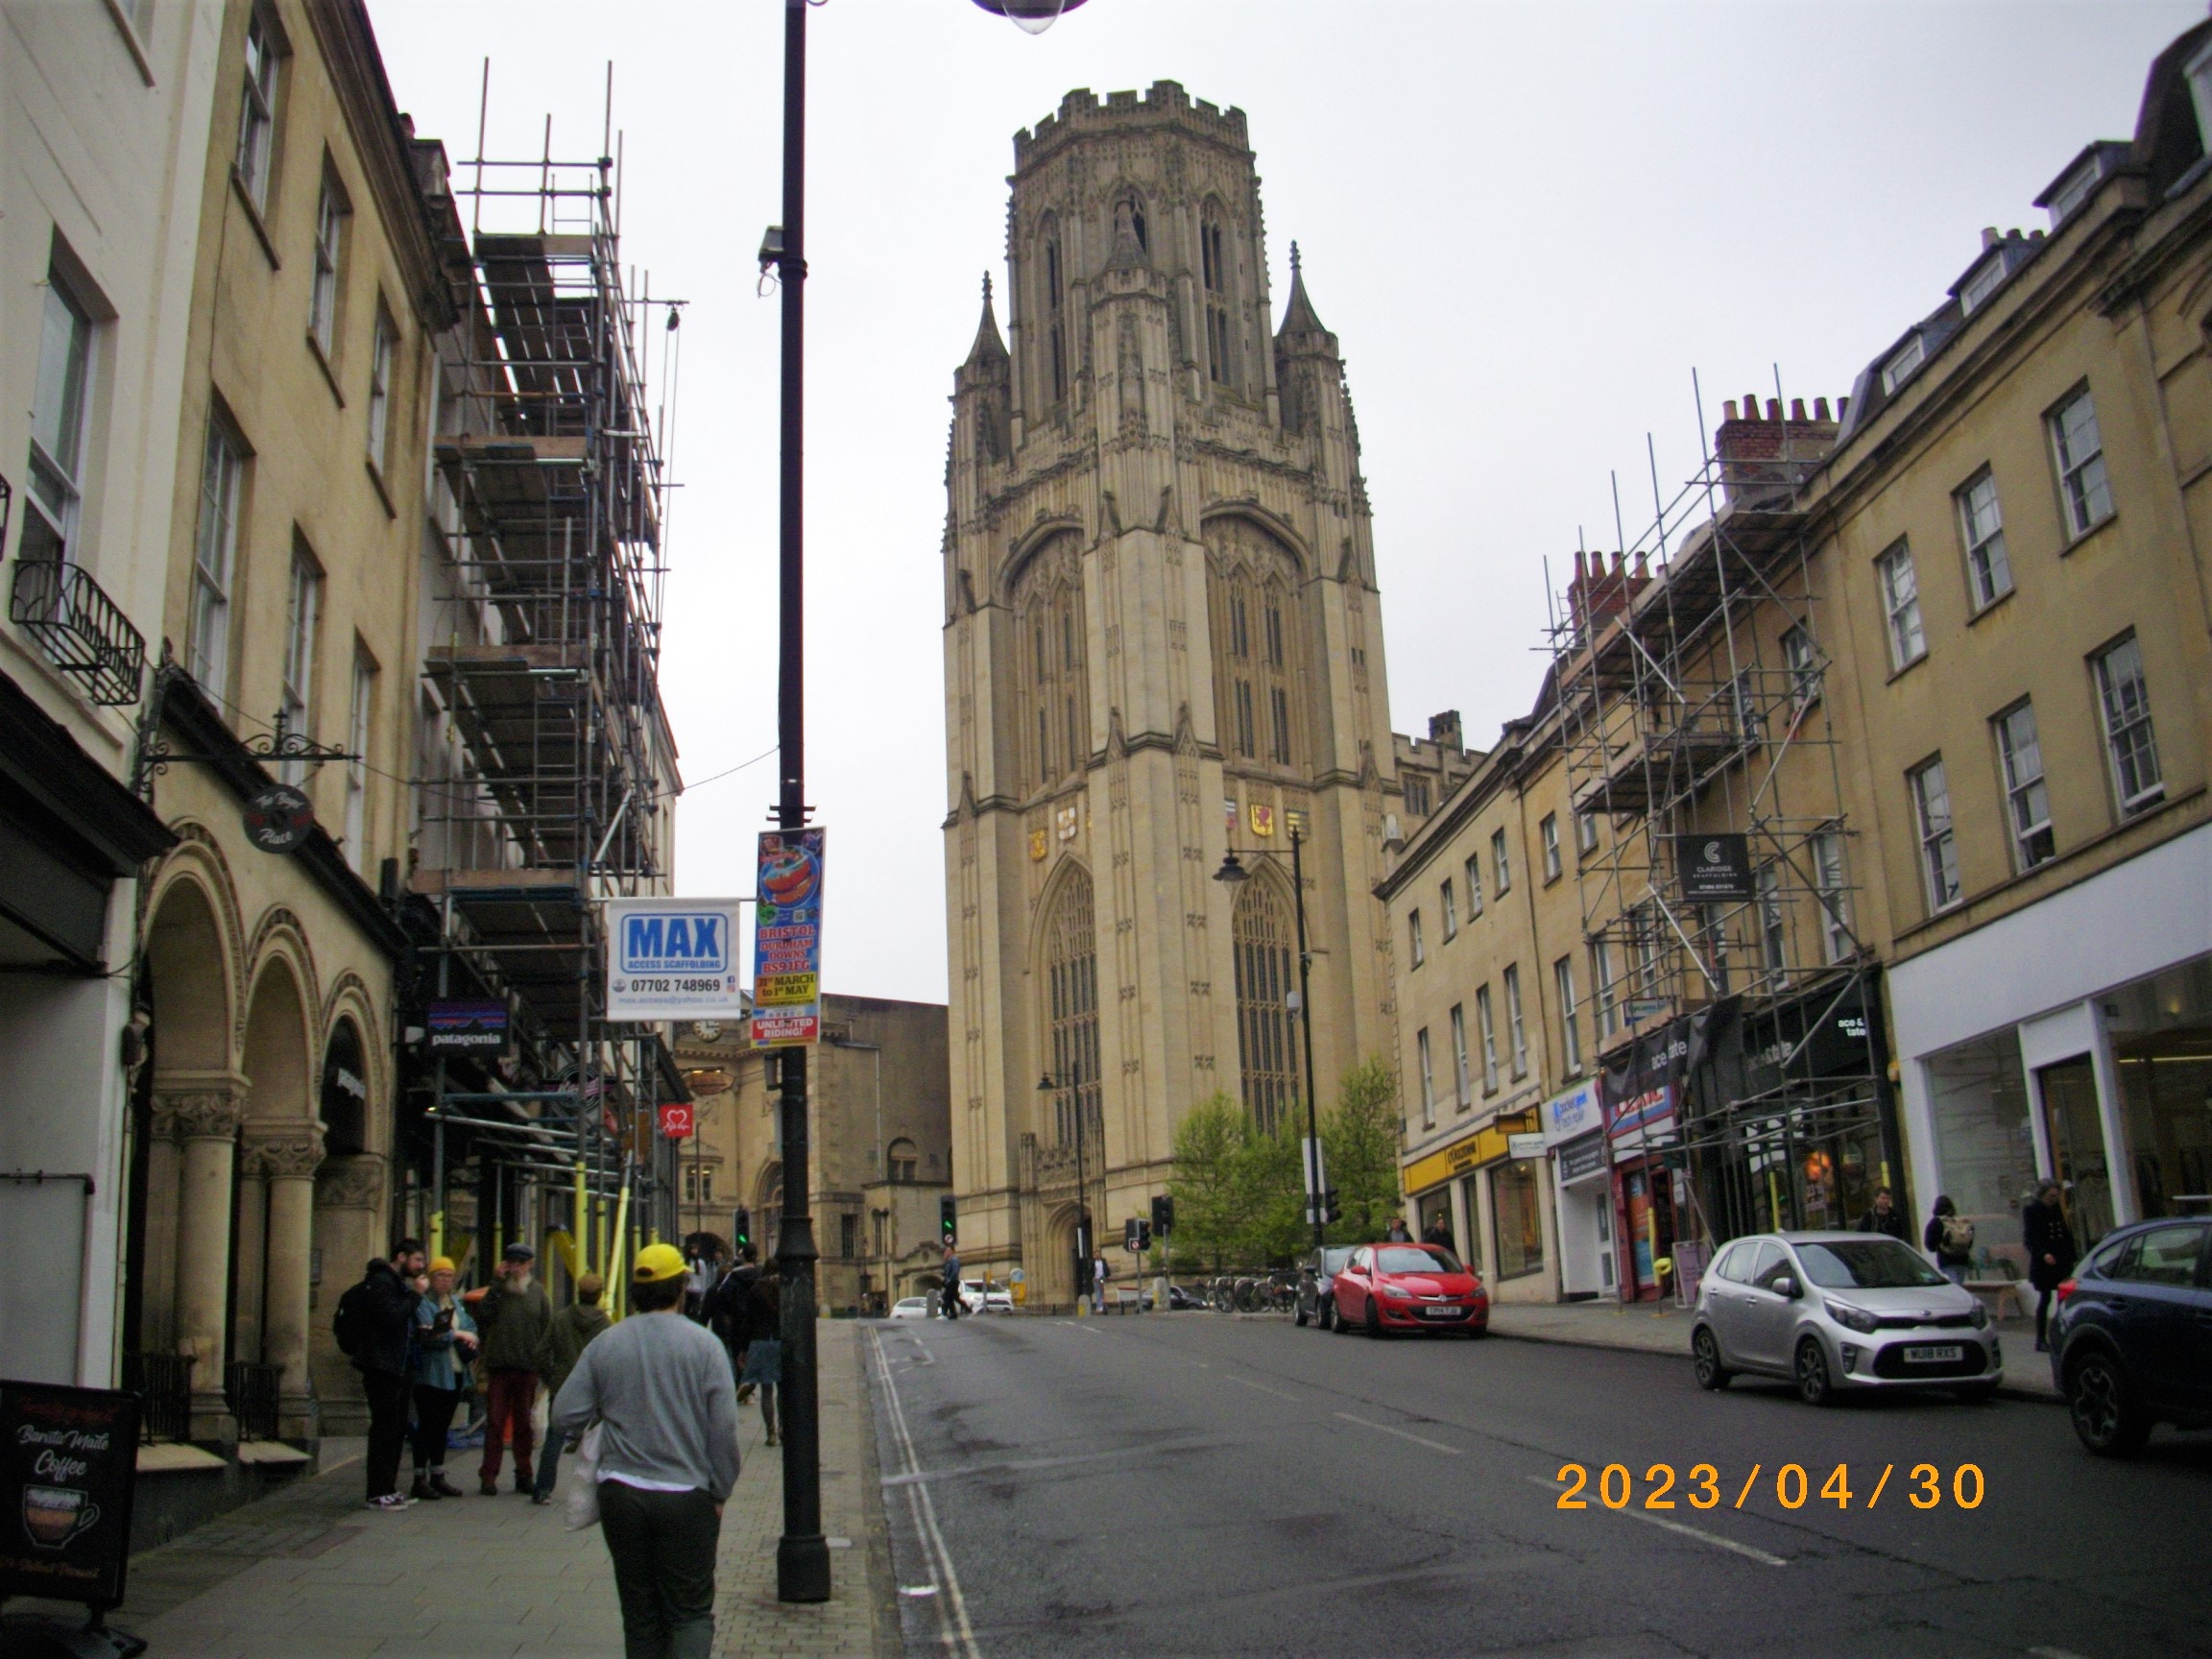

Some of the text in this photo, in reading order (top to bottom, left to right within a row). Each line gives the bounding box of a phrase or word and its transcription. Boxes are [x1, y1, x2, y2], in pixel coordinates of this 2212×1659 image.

[1695, 865, 1732, 874] CLARIDGE
[628, 918, 720, 958] MAX
[759, 925, 815, 940] BRISTOL
[760, 938, 813, 951] DURDHAM
[769, 950, 806, 960] DOWNS
[628, 960, 721, 969] ACCESS SCAFFOLDING
[631, 978, 721, 993] 07702 748969
[774, 974, 814, 987] MARCH
[762, 988, 773, 997] to
[785, 984, 809, 996] MAY
[1838, 1019, 1856, 1027] ace
[1846, 1027, 1866, 1037] tate
[432, 1032, 501, 1046] patagonia
[1668, 1040, 1688, 1060] ate
[17, 1424, 63, 1445] Barista
[35, 1449, 87, 1481] Coffee
